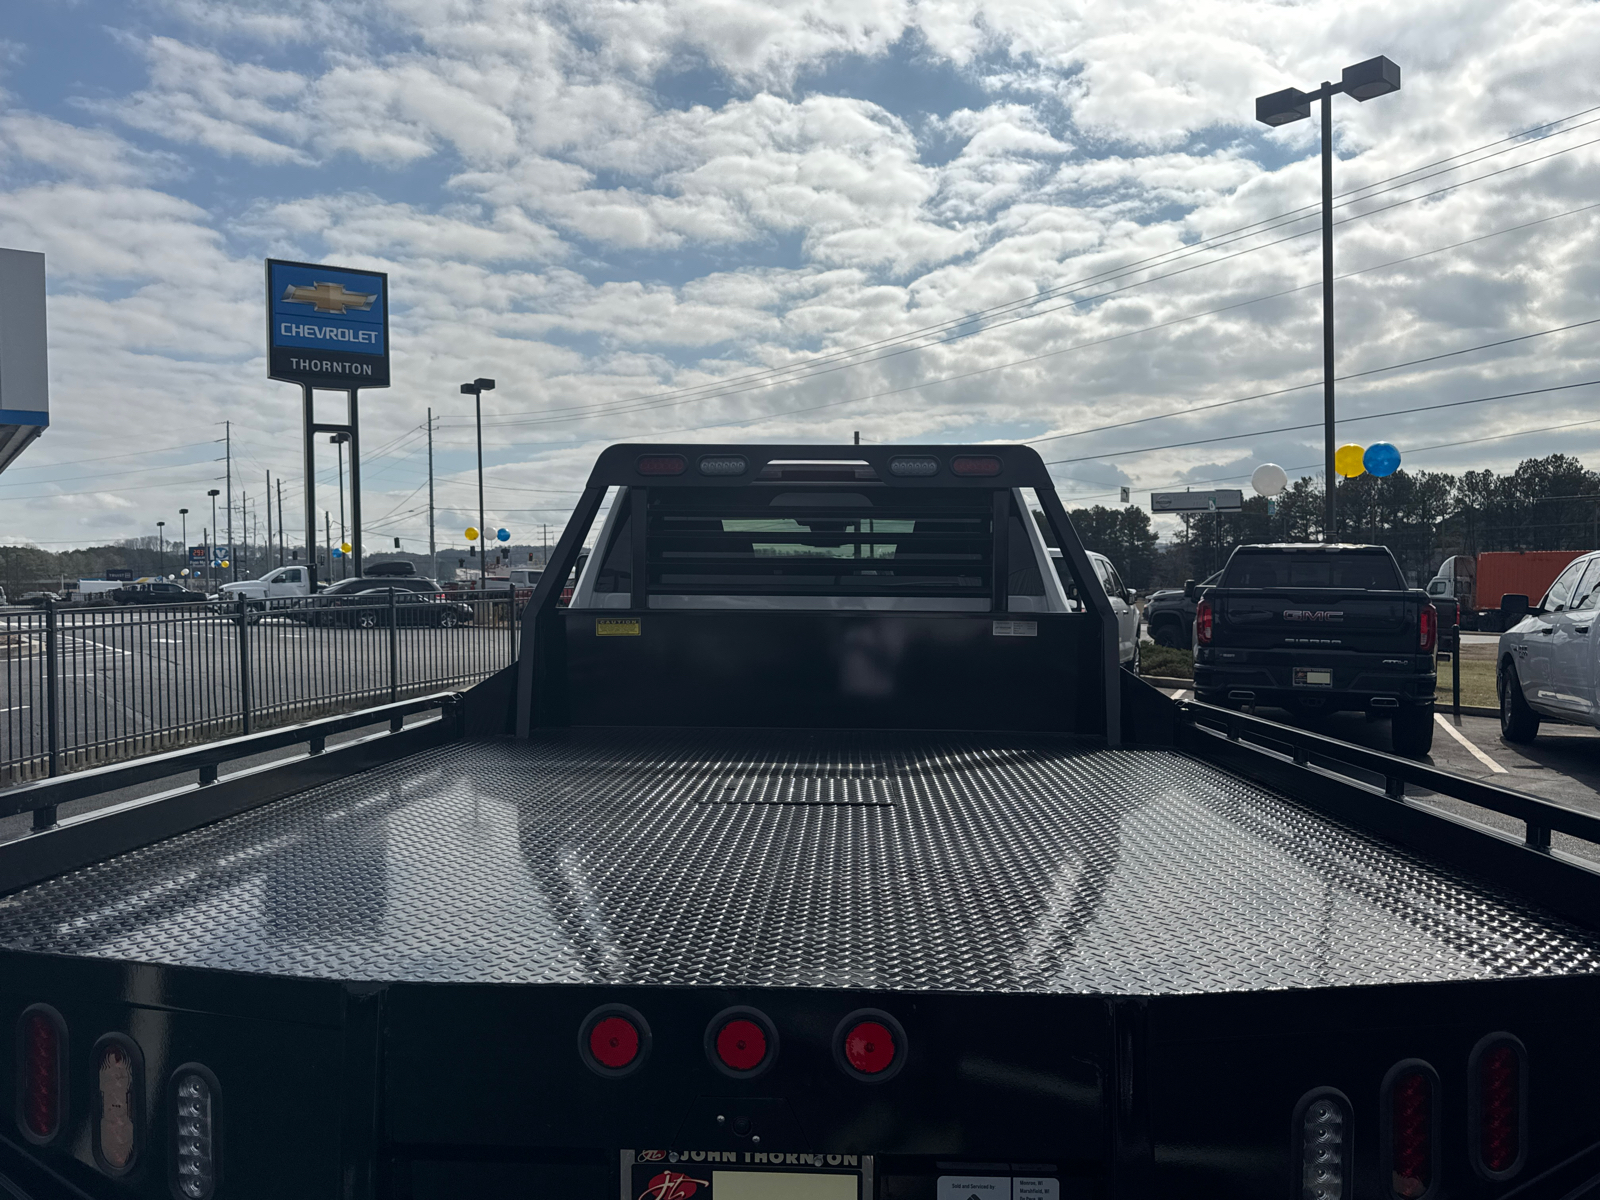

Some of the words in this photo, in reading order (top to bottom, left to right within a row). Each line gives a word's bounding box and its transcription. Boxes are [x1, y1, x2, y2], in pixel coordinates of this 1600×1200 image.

[280, 322, 378, 344] CHEVROLET
[290, 358, 372, 376] THORNTON
[1283, 610, 1344, 622] GMC
[680, 1151, 736, 1162] JOHN
